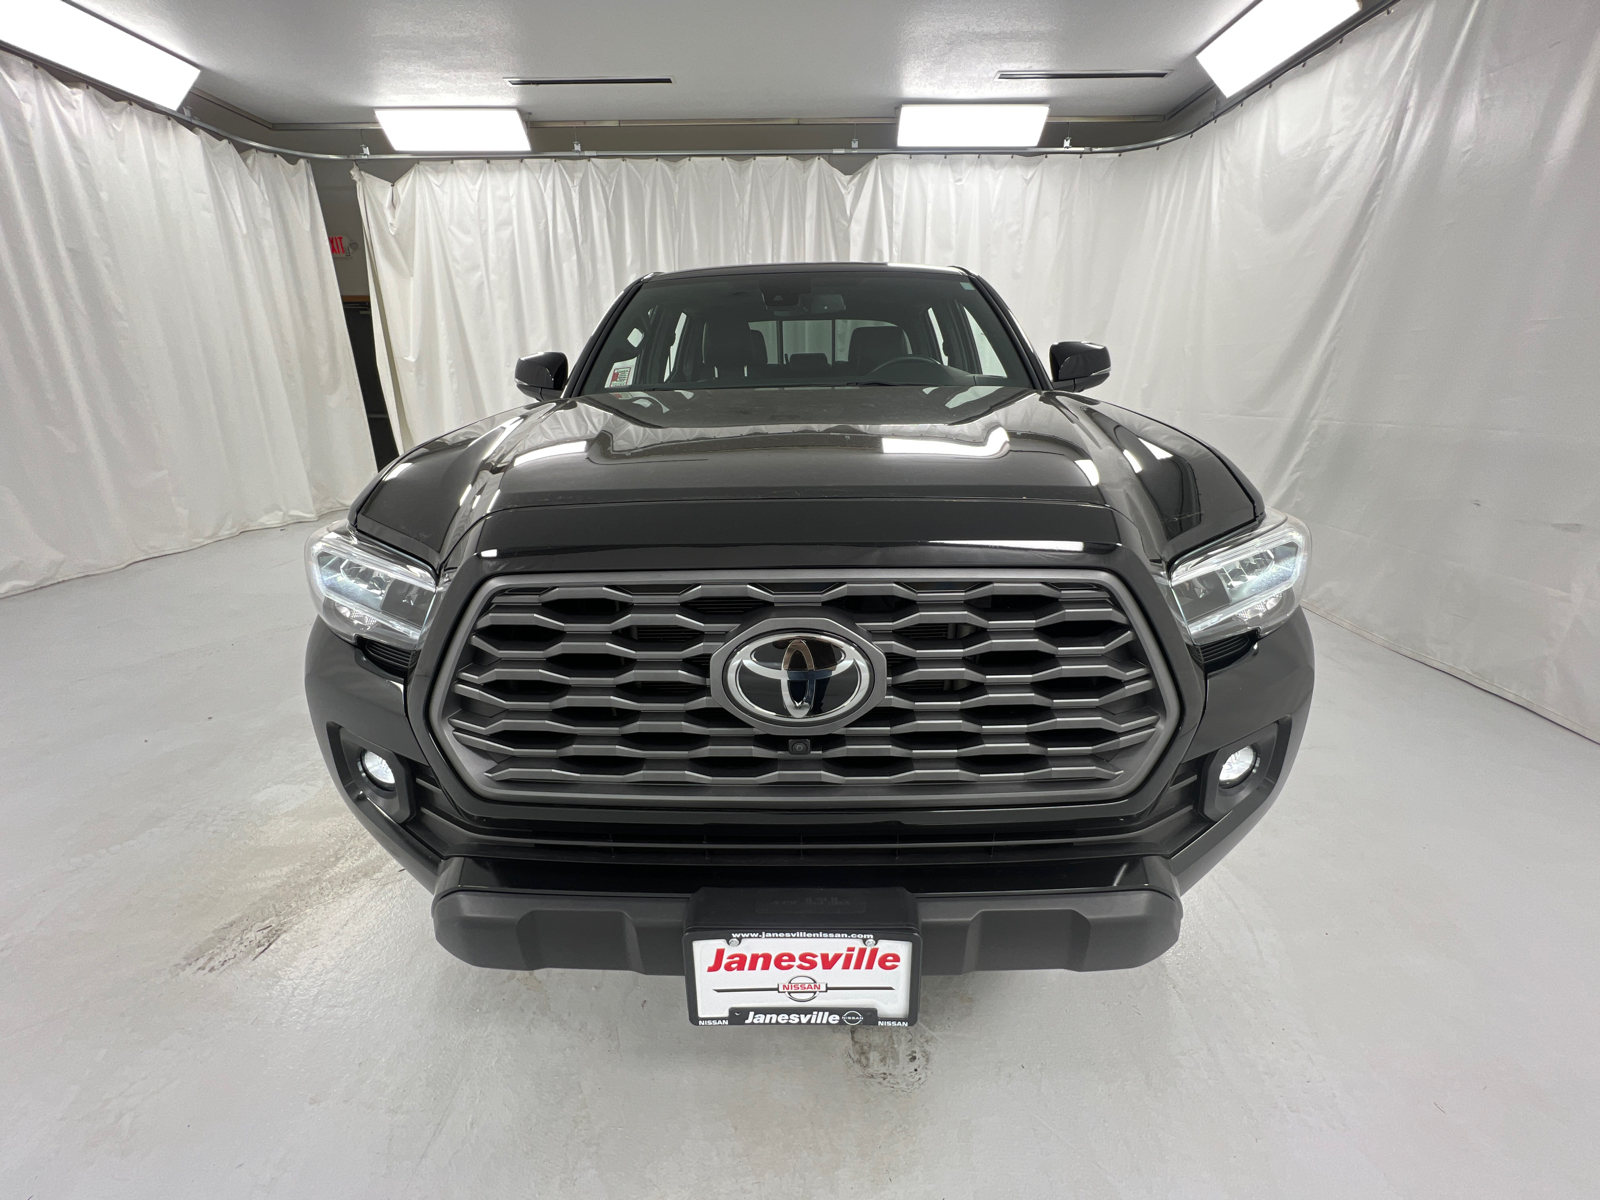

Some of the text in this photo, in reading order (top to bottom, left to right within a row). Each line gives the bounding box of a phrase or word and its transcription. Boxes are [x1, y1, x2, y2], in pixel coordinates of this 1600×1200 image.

[328, 236, 345, 254] XIT
[732, 931, 874, 939] www.janesvillenissan.com
[707, 947, 901, 973] Janesville
[782, 983, 821, 991] NISSAN
[744, 1011, 840, 1024] Janesville
